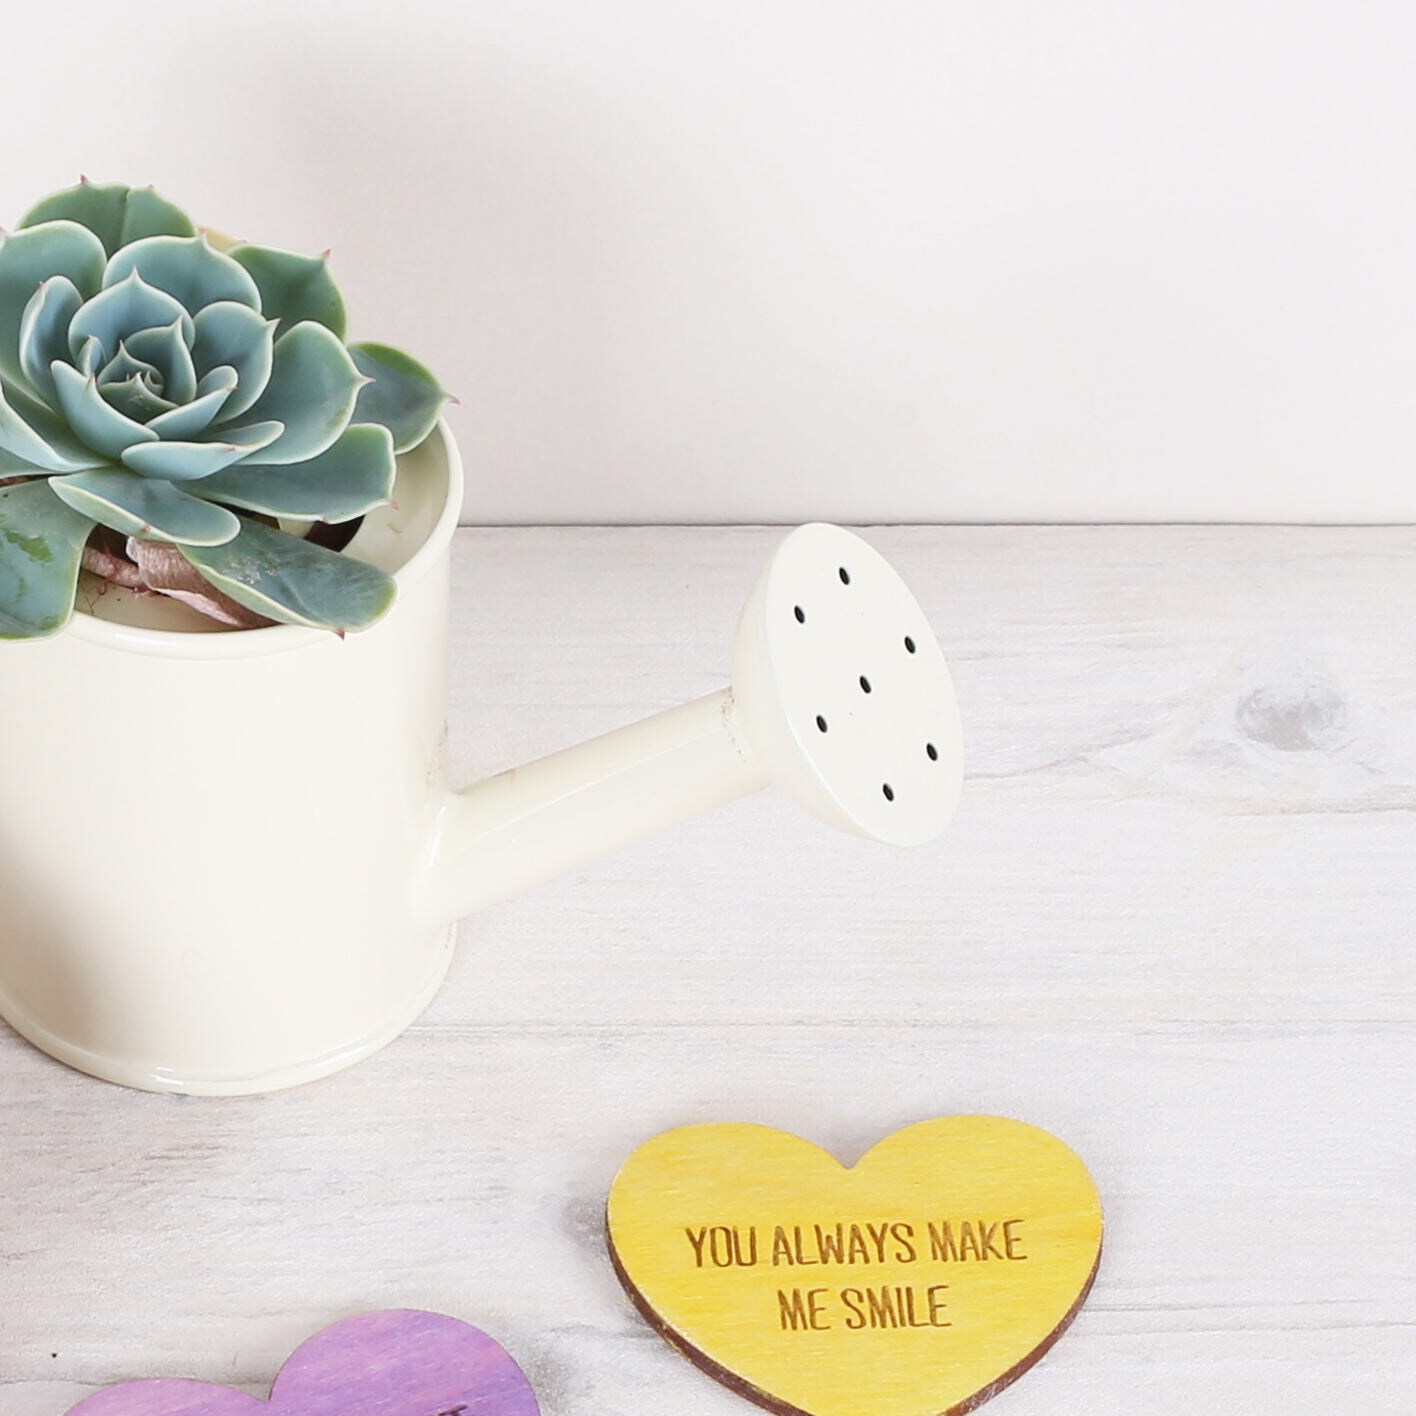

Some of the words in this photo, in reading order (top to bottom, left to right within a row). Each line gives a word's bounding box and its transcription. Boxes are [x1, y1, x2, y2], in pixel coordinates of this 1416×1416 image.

[684, 1225, 757, 1267] YOU
[772, 1222, 917, 1266] ALWAYS
[927, 1219, 1028, 1262] MAKE
[777, 1288, 831, 1330] ME
[840, 1285, 952, 1329] SMILE
